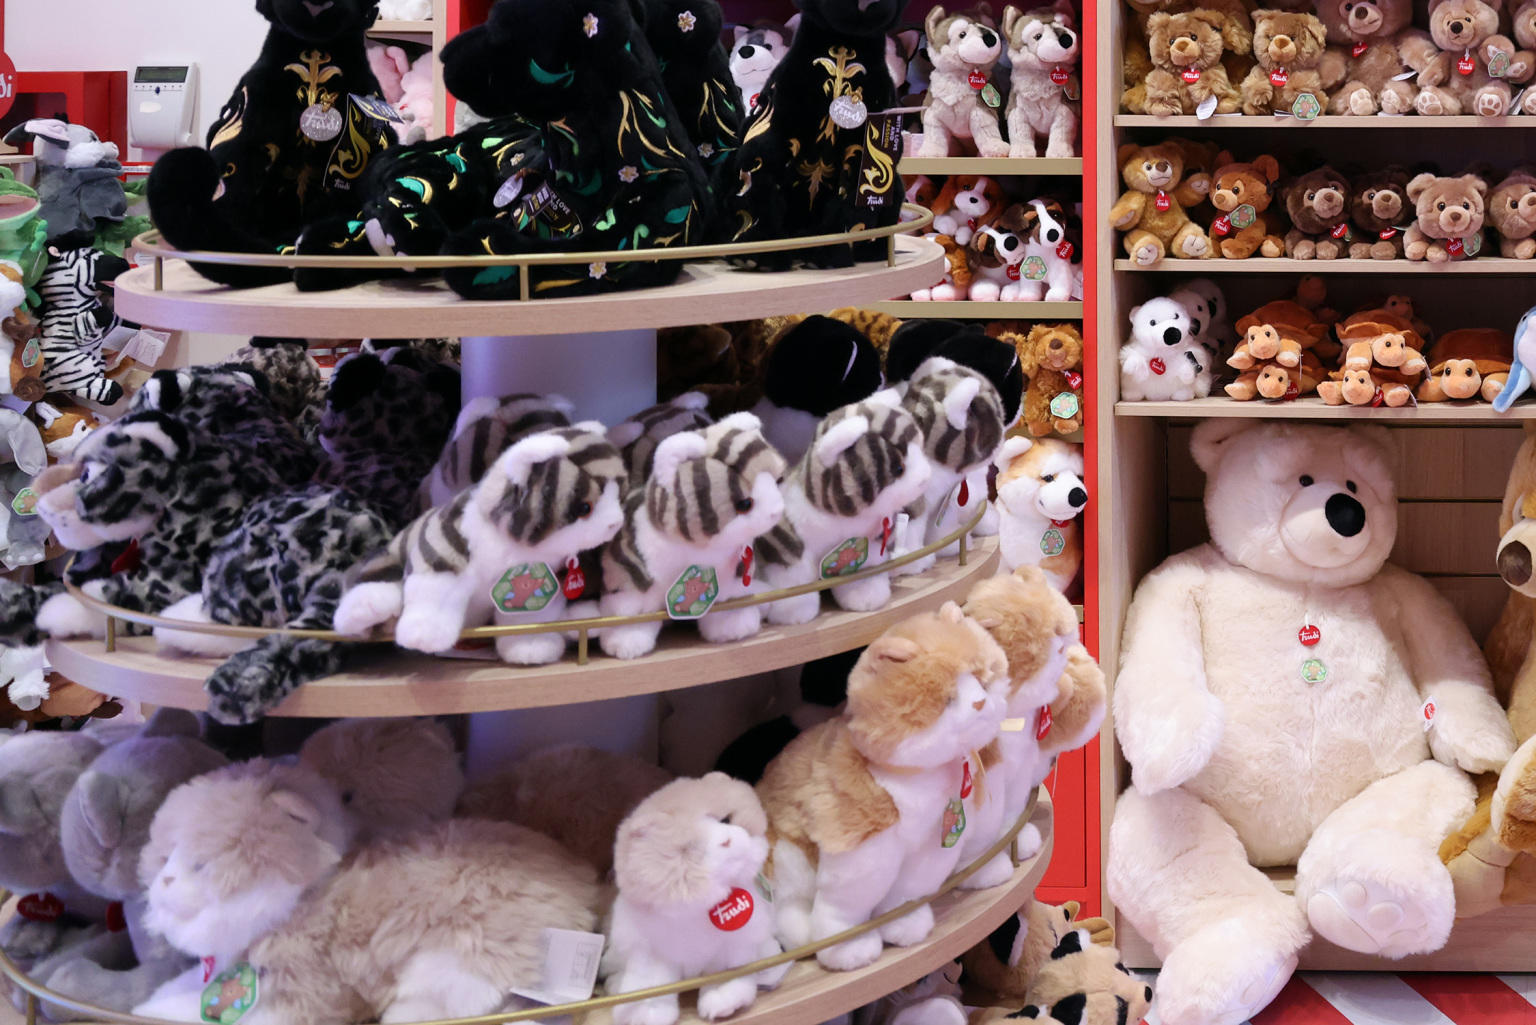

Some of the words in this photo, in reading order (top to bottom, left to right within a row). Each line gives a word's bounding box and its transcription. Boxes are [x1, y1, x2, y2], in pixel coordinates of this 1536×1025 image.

[304, 112, 340, 131] Trudi
[867, 195, 883, 205] Trudi
[1299, 630, 1319, 642] Trudi
[712, 895, 750, 926] Trudi
